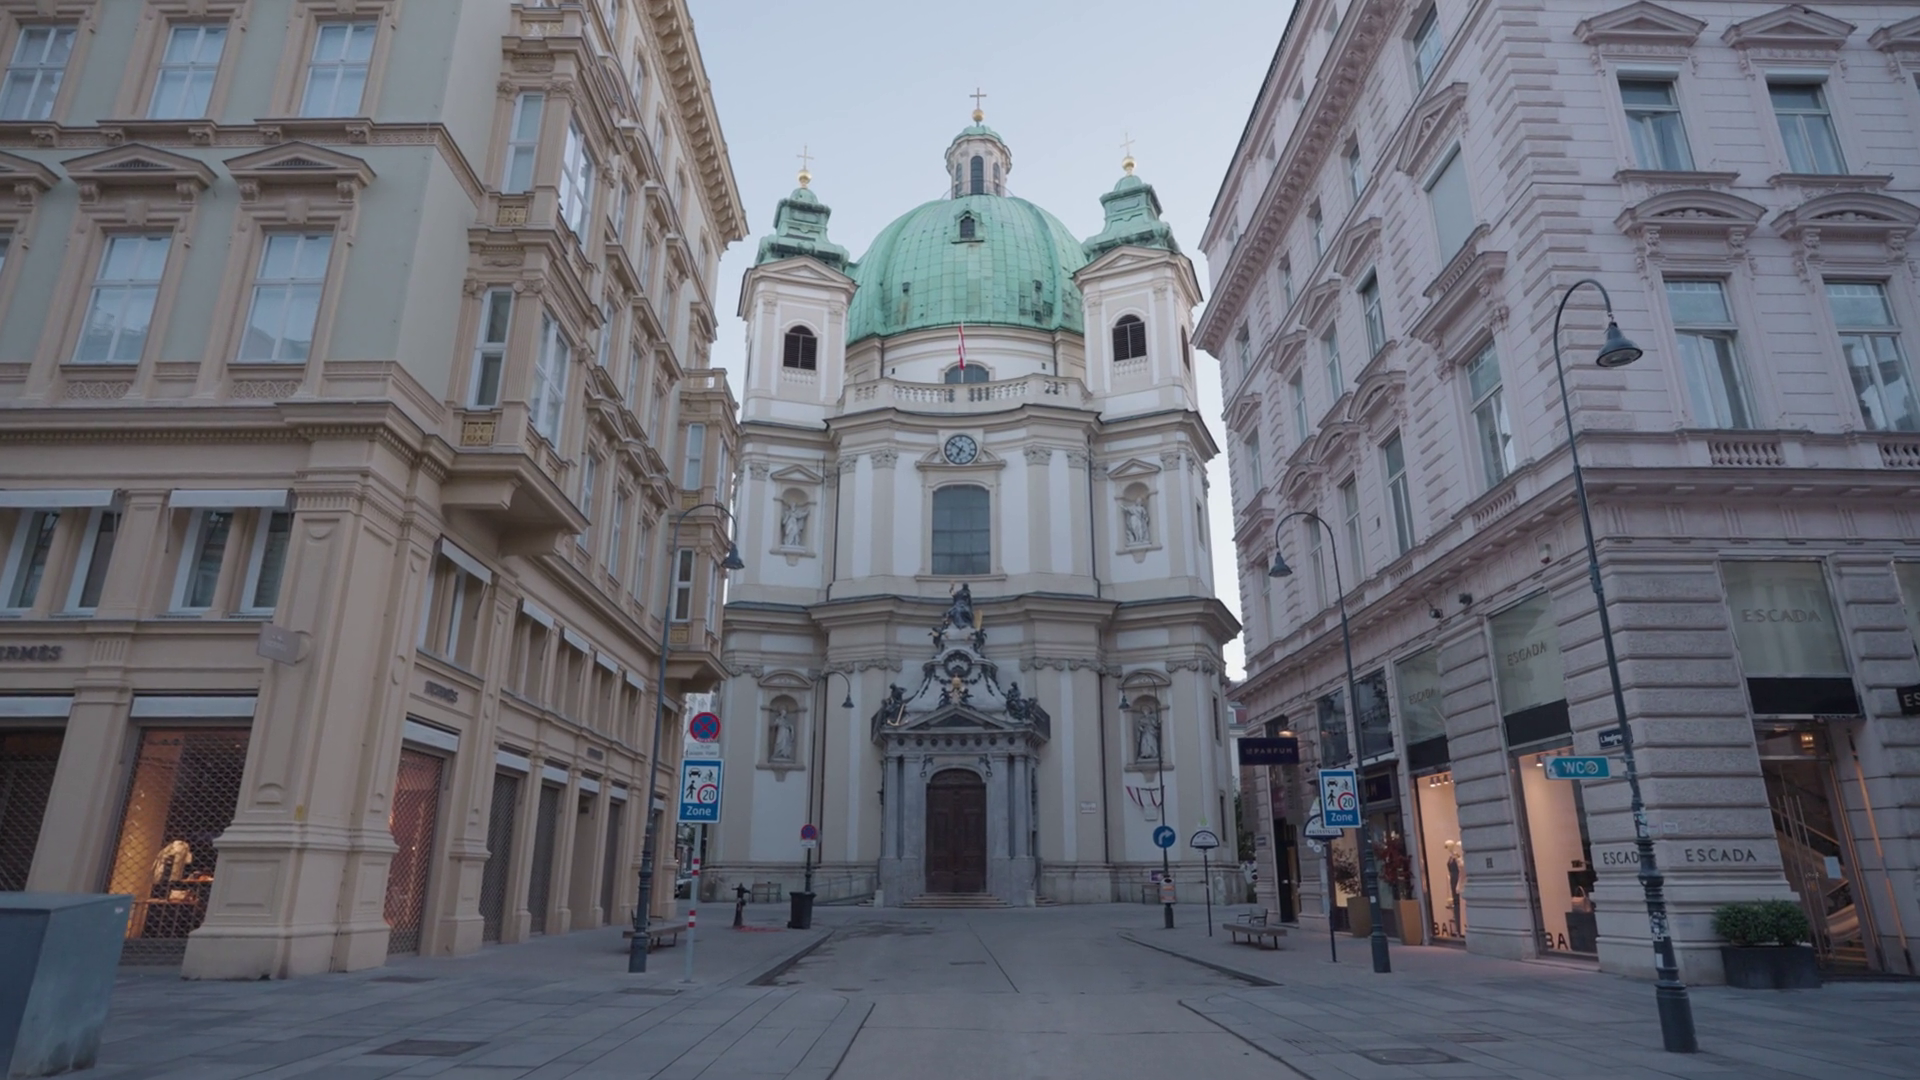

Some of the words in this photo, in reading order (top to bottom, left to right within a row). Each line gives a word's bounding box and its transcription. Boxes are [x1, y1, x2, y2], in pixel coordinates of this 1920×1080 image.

[1742, 608, 1823, 623] ESCADA
[1507, 640, 1548, 667] ESCADA
[1408, 686, 1436, 706] ESCADA
[1254, 747, 1293, 755] PARFUM
[1562, 761, 1585, 775] WC
[702, 789, 715, 801] 20
[1342, 797, 1354, 808] 20
[686, 805, 711, 816] Zone
[1330, 812, 1353, 822] Zone
[1602, 851, 1640, 866] ESCAD
[1685, 849, 1757, 863] ESCADA
